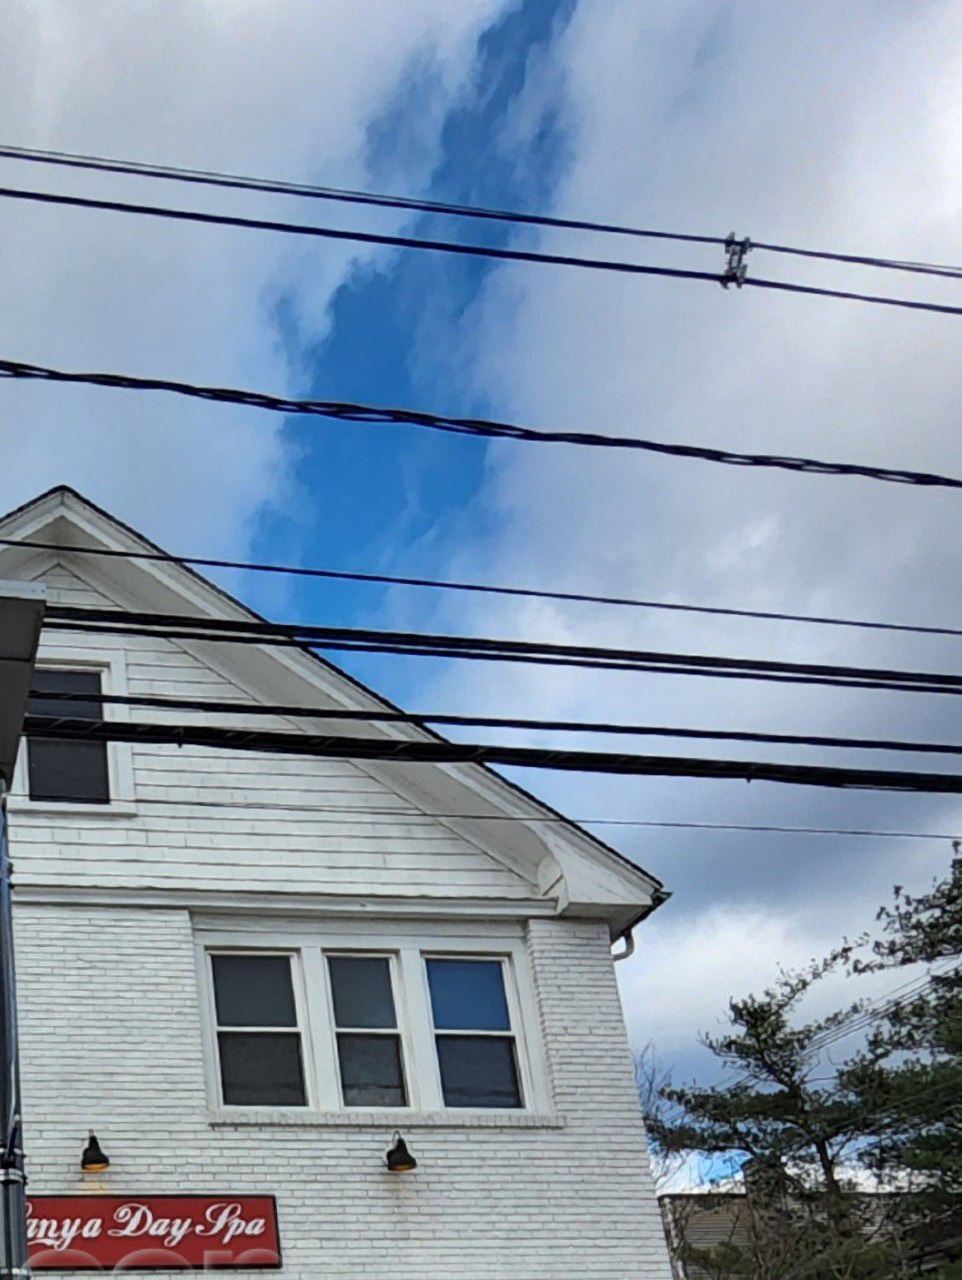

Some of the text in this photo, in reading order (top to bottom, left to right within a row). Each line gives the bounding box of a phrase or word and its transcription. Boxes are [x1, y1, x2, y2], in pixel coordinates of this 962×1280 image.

[25, 1201, 266, 1250] anya Day Spa
